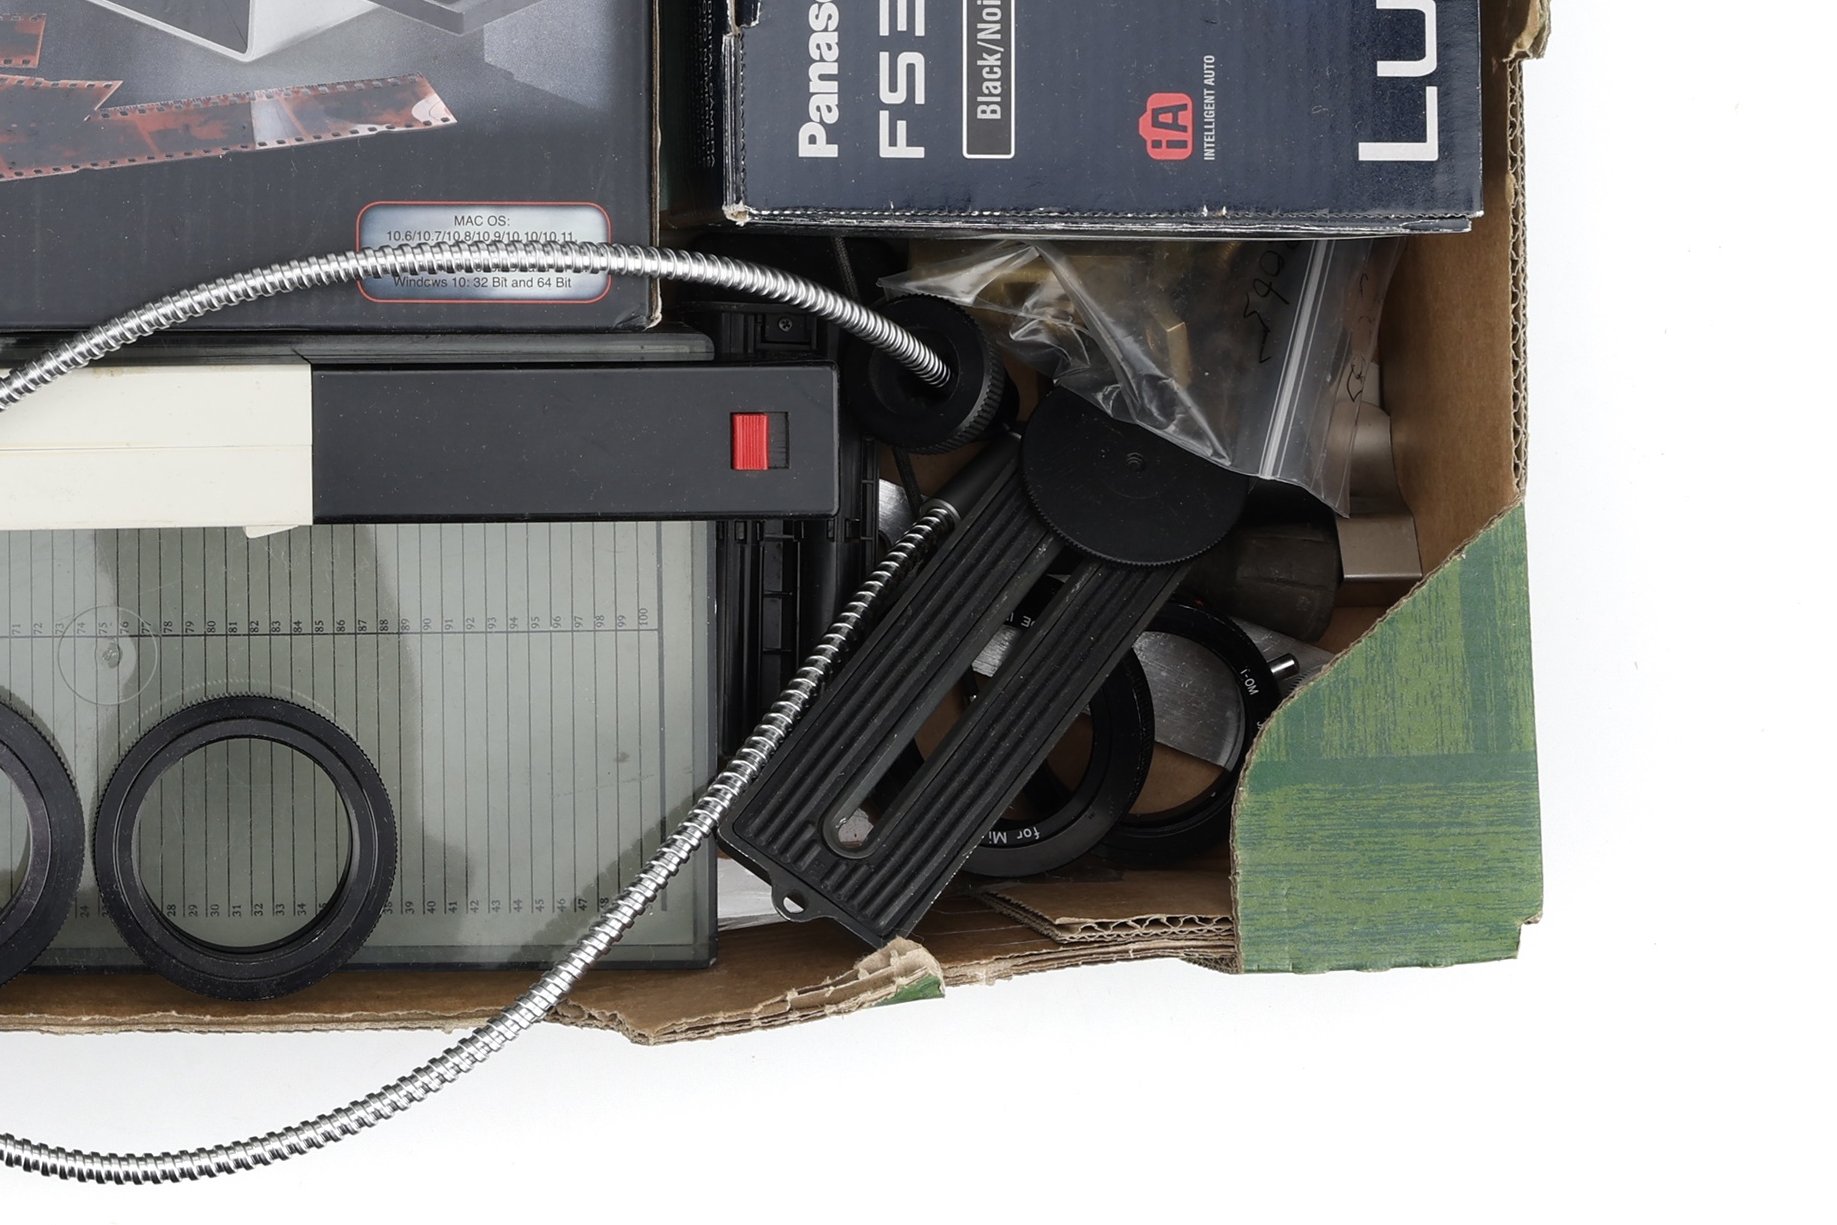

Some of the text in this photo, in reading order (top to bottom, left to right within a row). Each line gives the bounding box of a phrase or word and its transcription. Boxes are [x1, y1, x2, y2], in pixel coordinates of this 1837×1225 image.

[1204, 55, 1216, 160] INTELLIGENT AUTO
[453, 215, 511, 227] MAC OS:
[452, 277, 470, 288] 10:
[473, 277, 488, 288] 32
[492, 277, 508, 288] Bit
[511, 277, 534, 288] and
[537, 277, 552, 288] 64
[556, 277, 572, 288] Bit
[163, 619, 389, 634] 78 82 85 88
[1016, 826, 1041, 841] for
